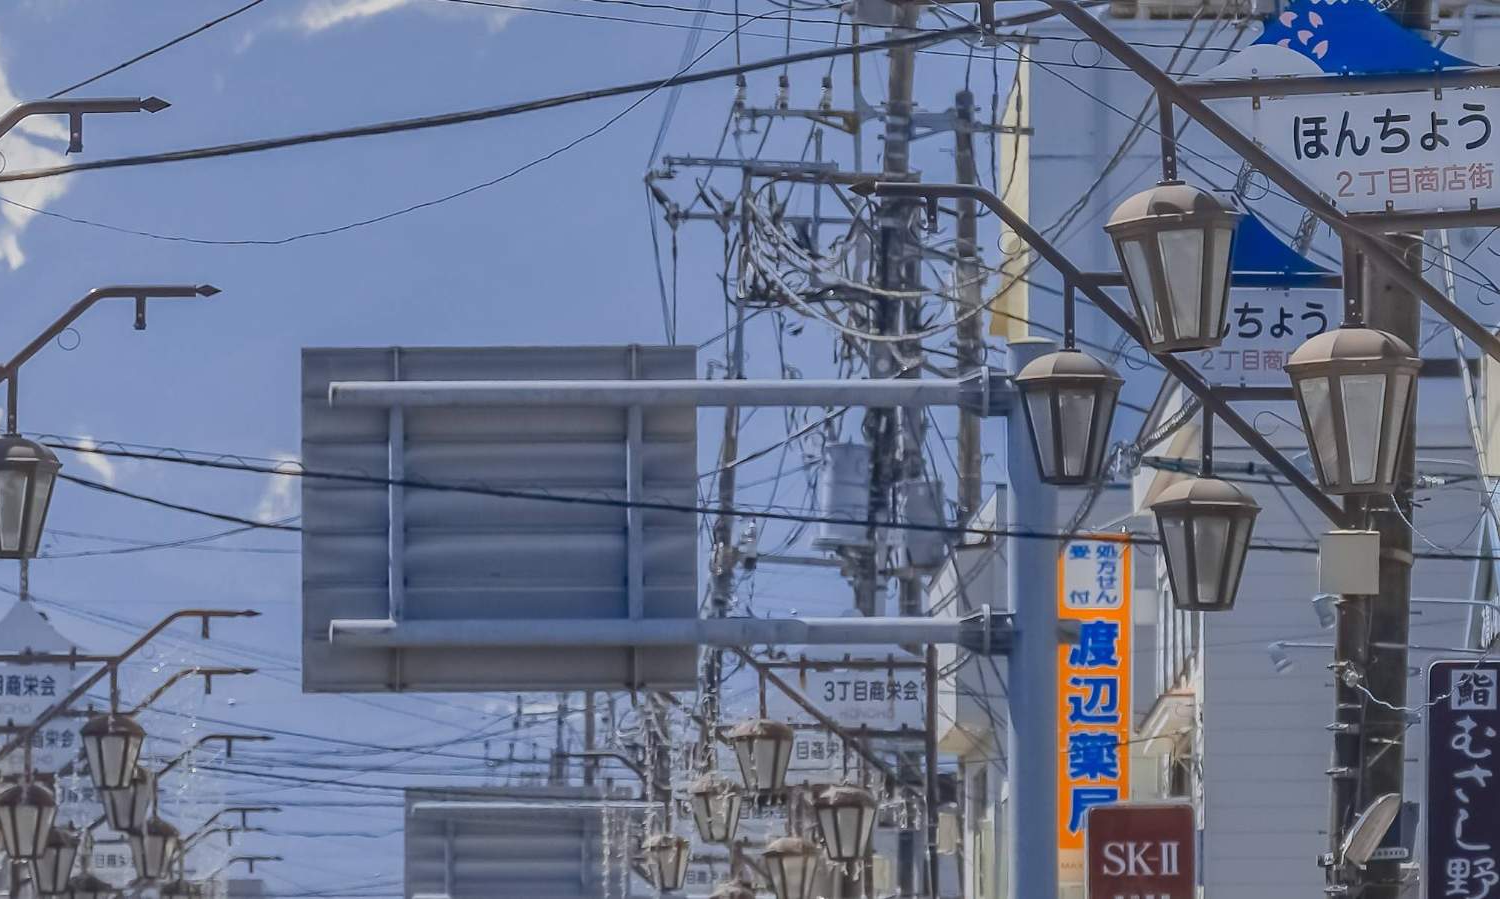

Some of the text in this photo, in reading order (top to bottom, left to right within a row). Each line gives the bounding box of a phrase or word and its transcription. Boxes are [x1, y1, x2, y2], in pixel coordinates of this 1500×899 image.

[1293, 103, 1492, 160] ほんちょう
[1336, 163, 1494, 198] 2丁目商店街
[1222, 302, 1328, 339] ちょう
[1200, 350, 1297, 371] 2丁目商
[1103, 842, 1180, 876] SK-II
